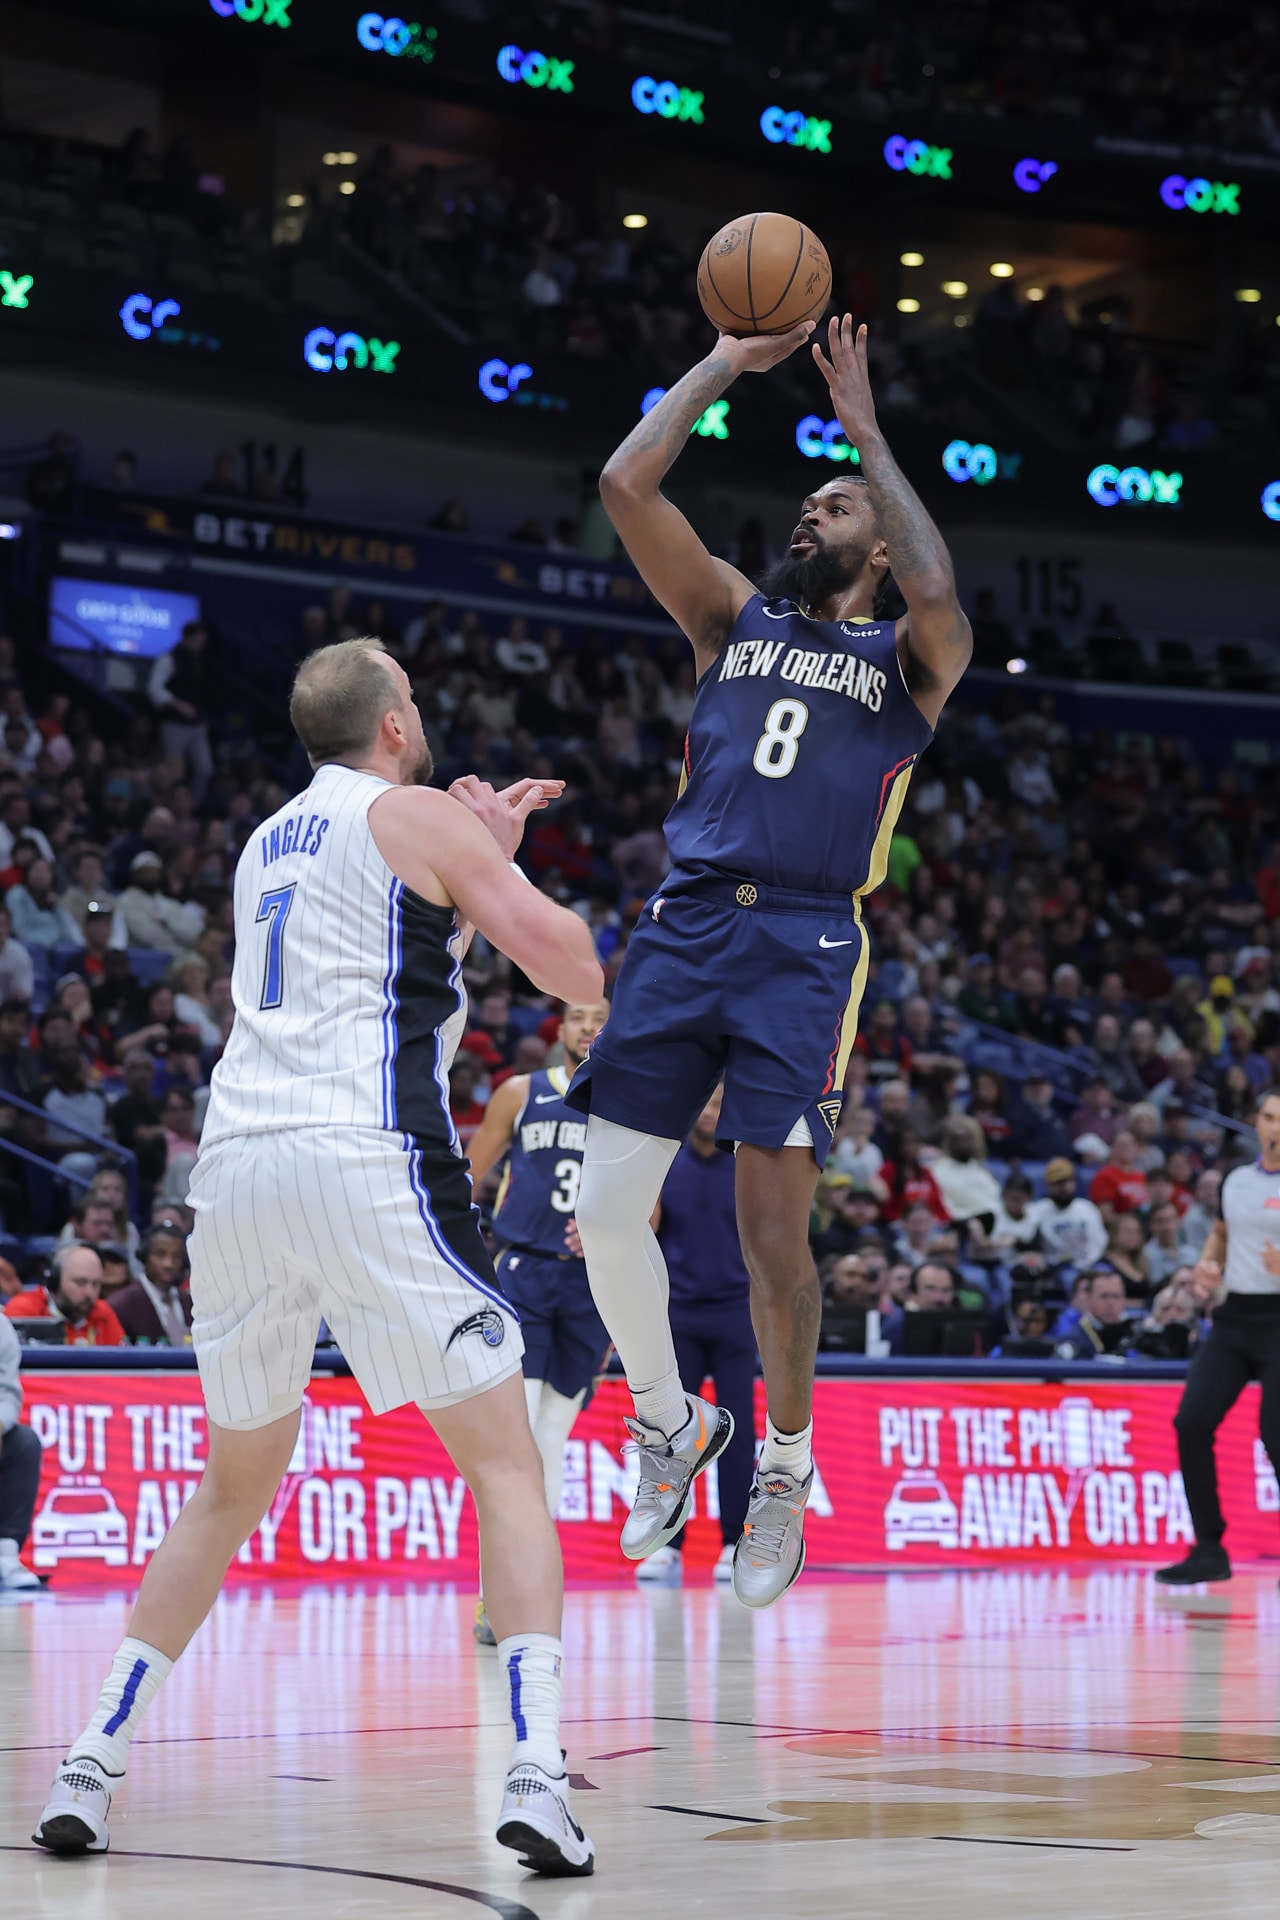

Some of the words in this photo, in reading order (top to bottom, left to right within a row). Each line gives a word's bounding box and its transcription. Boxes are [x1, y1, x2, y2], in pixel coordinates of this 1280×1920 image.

[497, 44, 575, 94] COX
[631, 76, 705, 125] COX
[760, 105, 832, 154] COX
[883, 134, 954, 180] COX
[1160, 174, 1242, 216] COX
[1016, 556, 1083, 619] 115
[718, 639, 786, 683] NEW
[779, 648, 888, 713] ORLEANS
[753, 698, 809, 779] 8
[261, 814, 329, 868] INGLES
[255, 881, 298, 1011] 7
[521, 1119, 559, 1153] NEW
[551, 1158, 582, 1213] 3
[29, 1404, 113, 1473] PUT
[124, 1404, 207, 1472] THE
[879, 1407, 943, 1468] PUT
[951, 1408, 1015, 1467] THE
[299, 1477, 367, 1563] OR
[374, 1475, 466, 1561] PAY
[960, 1472, 1087, 1549] AWAY
[1084, 1470, 1140, 1546] OR
[1141, 1470, 1197, 1546] PA
[76, 1761, 97, 1773] GIGI
[517, 1767, 538, 1776] GIGI
